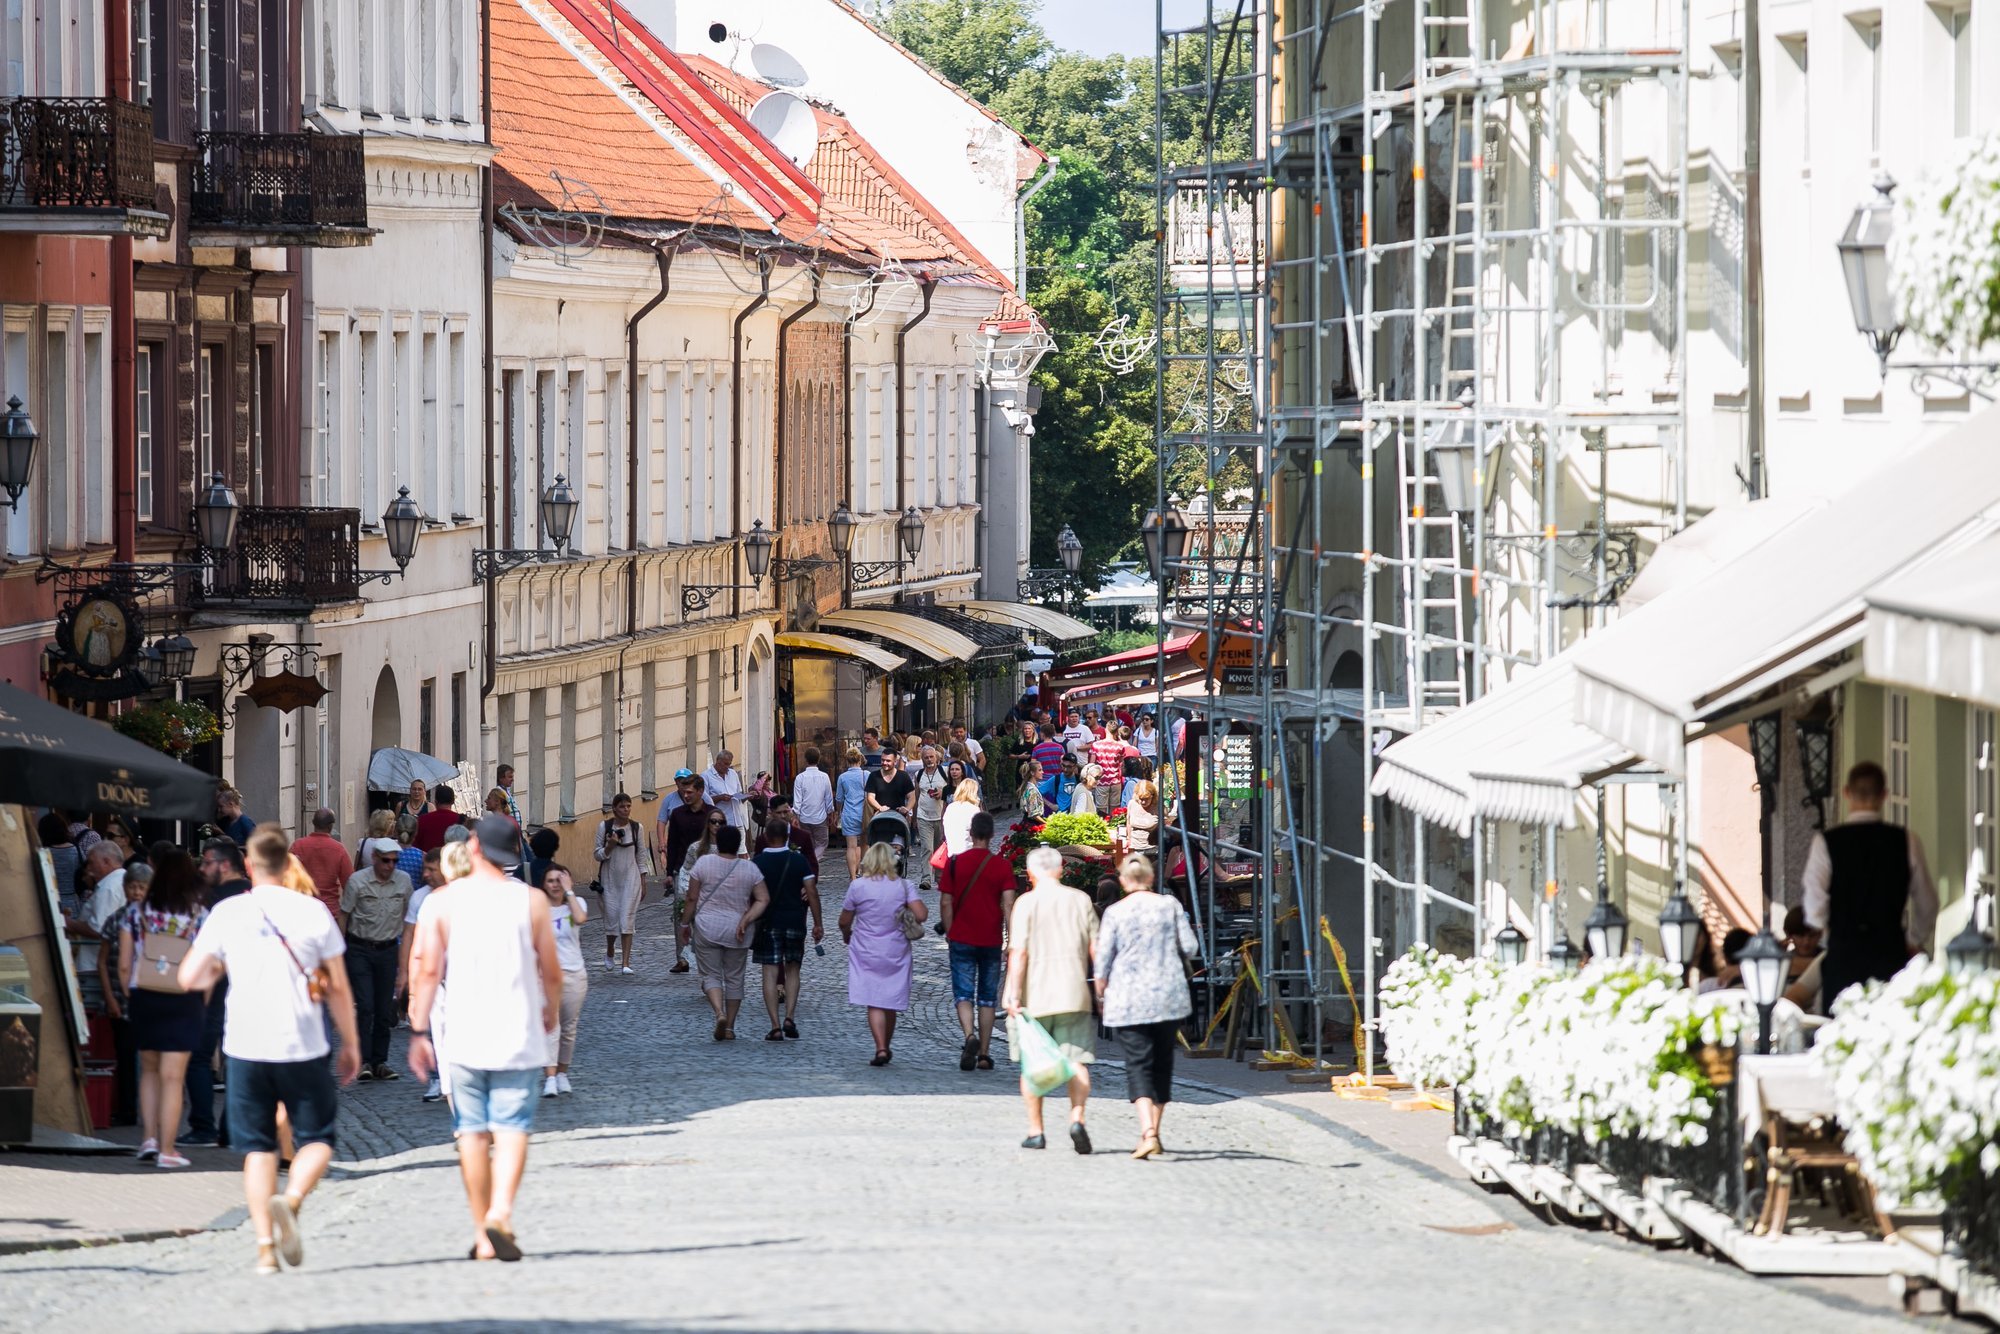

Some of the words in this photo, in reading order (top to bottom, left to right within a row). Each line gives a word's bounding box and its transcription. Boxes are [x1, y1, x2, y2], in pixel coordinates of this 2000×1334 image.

[1199, 649, 1252, 660] CFFEINE
[1228, 674, 1280, 684] KNYGS
[97, 782, 152, 807] DIONE
